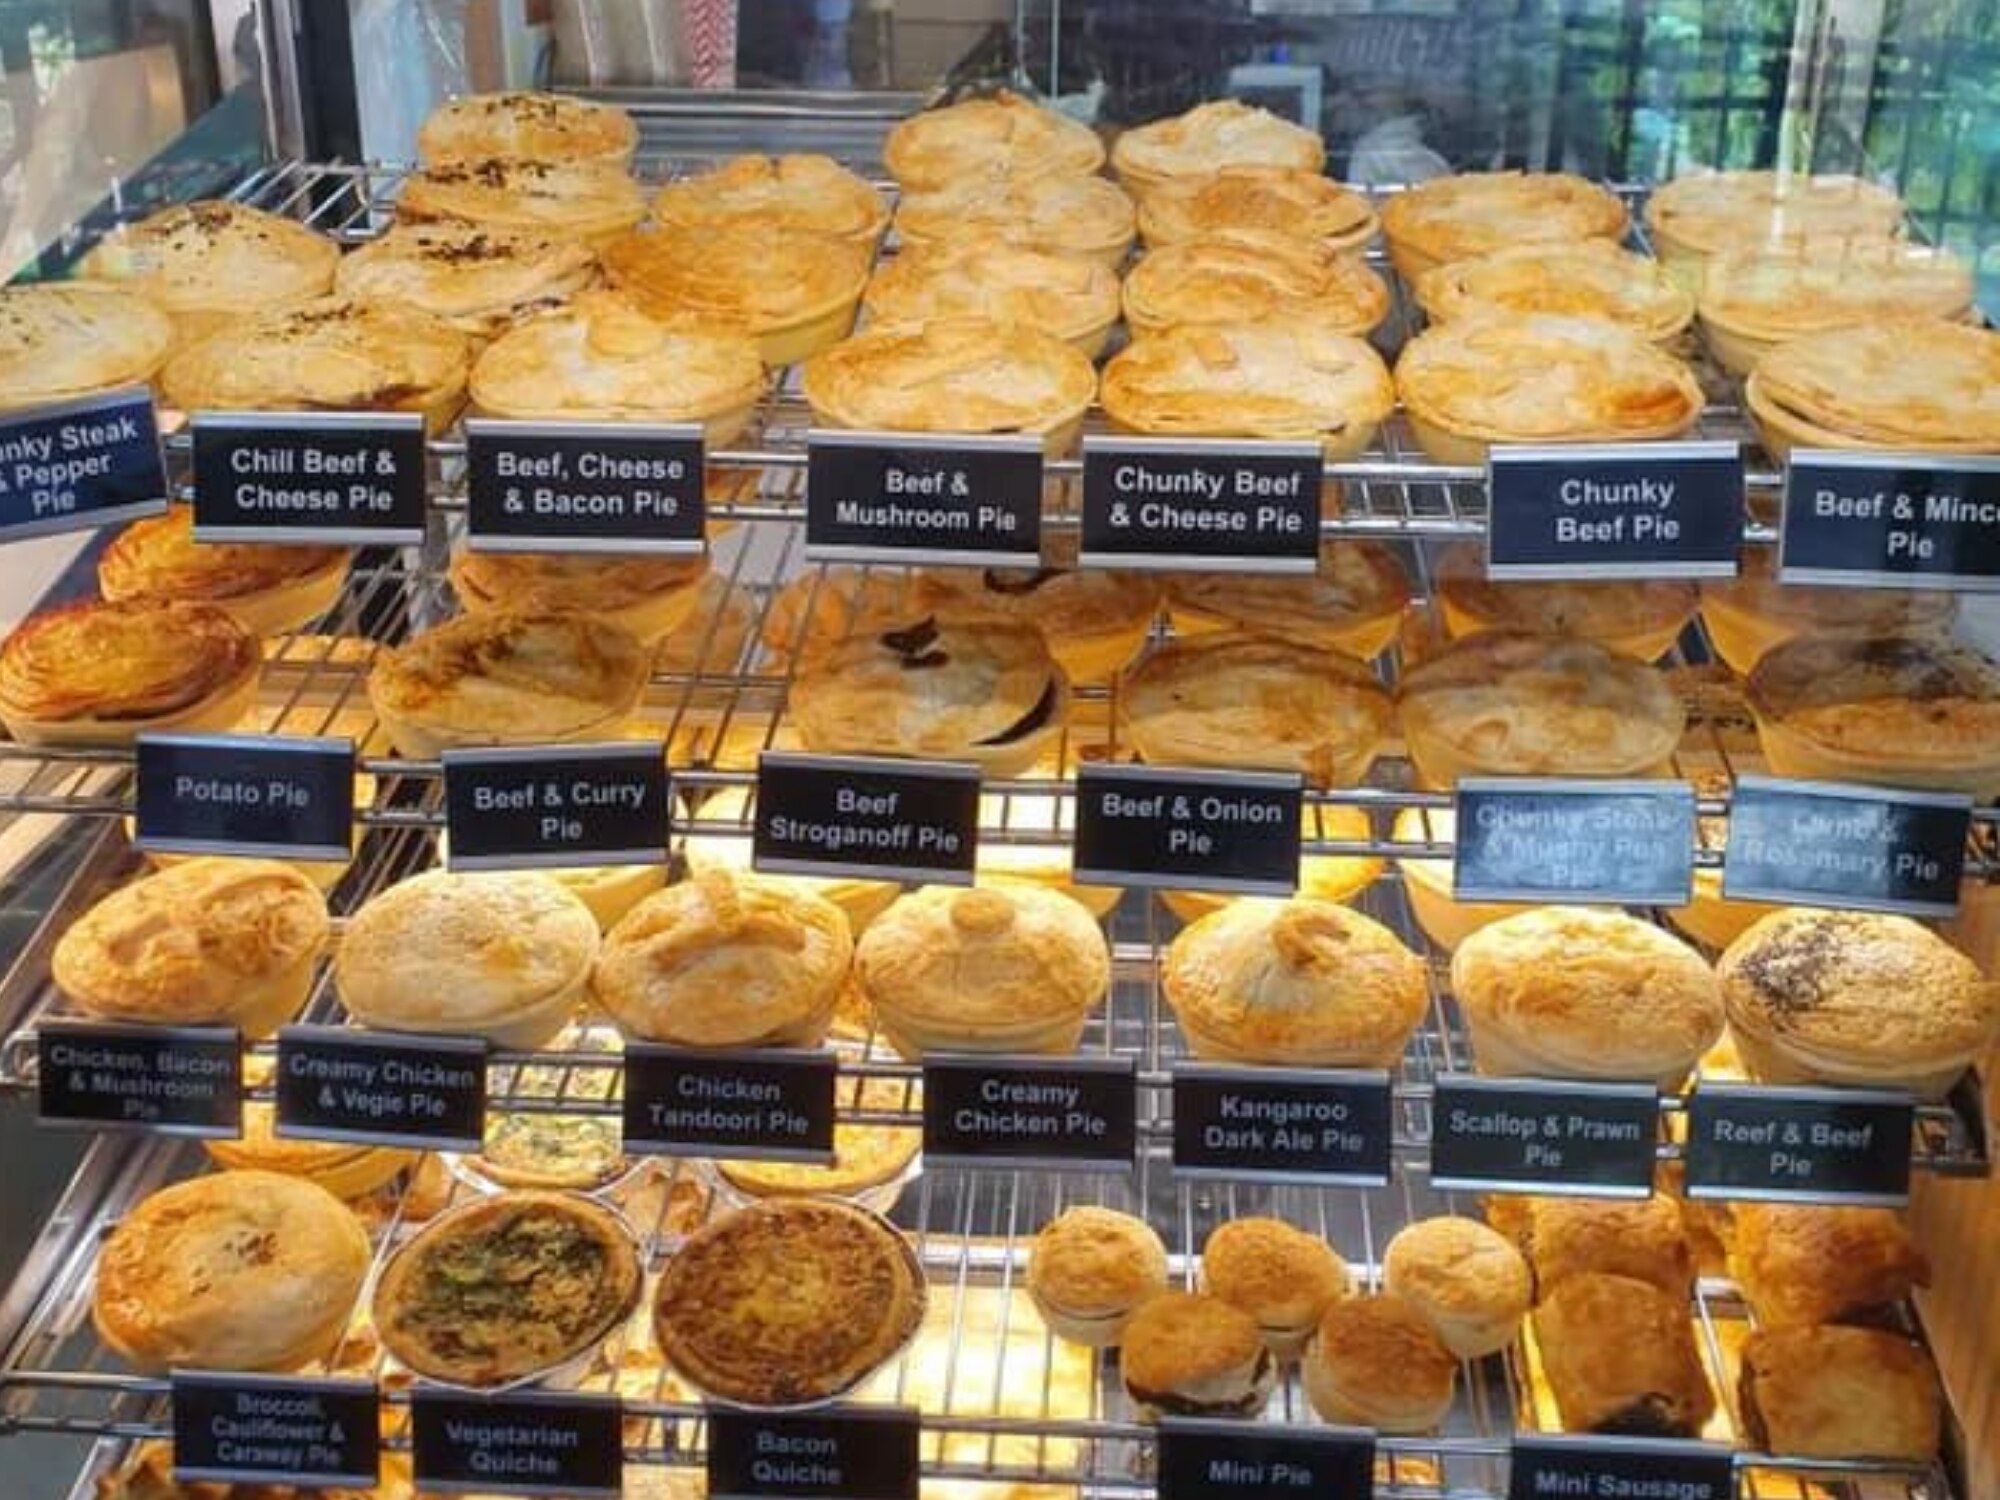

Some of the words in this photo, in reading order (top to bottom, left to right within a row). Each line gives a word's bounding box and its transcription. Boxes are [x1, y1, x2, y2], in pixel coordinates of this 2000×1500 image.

[0, 435, 52, 462] nky
[60, 416, 138, 450] Steak
[15, 454, 112, 490] Pepper
[231, 448, 294, 474] Chill
[303, 448, 368, 474] Beef
[375, 450, 397, 474] &
[497, 452, 568, 480] Beef,
[578, 455, 684, 481] Cheese
[885, 469, 944, 494] Beef
[951, 474, 969, 496] &
[1114, 466, 1224, 499] Chunky
[1234, 471, 1300, 496] Beef
[1560, 478, 1675, 506] Chunky
[31, 489, 76, 515] Pie
[236, 483, 340, 510] Cheese
[349, 485, 393, 511] Pie
[504, 491, 525, 514] &
[533, 489, 624, 515] Bacon
[633, 493, 678, 517] Pie
[1815, 490, 1884, 518] Beef
[1892, 494, 1914, 519] &
[1925, 495, 2000, 524] Minc
[836, 502, 970, 530] Mushroom
[977, 507, 1017, 532] Pie
[1109, 503, 1130, 527] &
[1140, 504, 1247, 530] Cheese
[1257, 508, 1302, 532] Pie
[1556, 517, 1624, 543] Beef
[1633, 515, 1680, 540] Pie
[1887, 531, 1934, 558] Pie
[175, 776, 260, 804] Potato
[267, 781, 309, 808] Pie
[474, 784, 535, 811] Beef
[543, 784, 562, 806] &
[572, 780, 645, 808] Curry
[836, 789, 897, 816] Beef
[1102, 793, 1161, 818] Beef
[1171, 797, 1190, 819] &
[1200, 797, 1283, 823] Onion
[541, 816, 583, 840] Pie
[769, 817, 911, 849] Stroganoff
[918, 827, 959, 852] Pie
[1169, 829, 1211, 854] Pie
[1896, 853, 1938, 880] Pie
[91, 1072, 214, 1097] Mushroom
[290, 1054, 375, 1084] Creamy
[383, 1061, 474, 1088] Chicken
[677, 1074, 781, 1101] Chicken
[980, 1079, 1080, 1109] Creamy
[318, 1087, 336, 1107] &
[343, 1090, 401, 1116] Vegie
[410, 1094, 446, 1117] Pie
[1220, 1094, 1349, 1124] Kangaroo
[648, 1103, 760, 1131] Tandoori
[769, 1112, 808, 1135] Pie
[955, 1110, 1058, 1135] Chicken
[1065, 1112, 1107, 1137] Pie
[1450, 1109, 1537, 1140] Scallop
[1543, 1115, 1560, 1138] &
[1567, 1116, 1641, 1140] Prawn
[1713, 1118, 1776, 1144] Reef
[1782, 1122, 1802, 1145] &
[1810, 1122, 1873, 1147] Beef
[1205, 1125, 1265, 1149] Dark
[1272, 1127, 1314, 1150] Ale
[1322, 1129, 1364, 1151] Pie
[1524, 1145, 1563, 1167] Pie
[1770, 1151, 1812, 1176] Pie
[445, 1420, 578, 1447] Vegetarian
[756, 1431, 837, 1455] Bacon
[308, 1445, 341, 1467] Pie
[470, 1451, 559, 1474] Quiche
[752, 1460, 843, 1485] Quiche
[1208, 1460, 1264, 1485] Mini
[1270, 1462, 1312, 1487] Pie
[1535, 1470, 1591, 1494] Mini
[1597, 1475, 1714, 1500] Sausage
